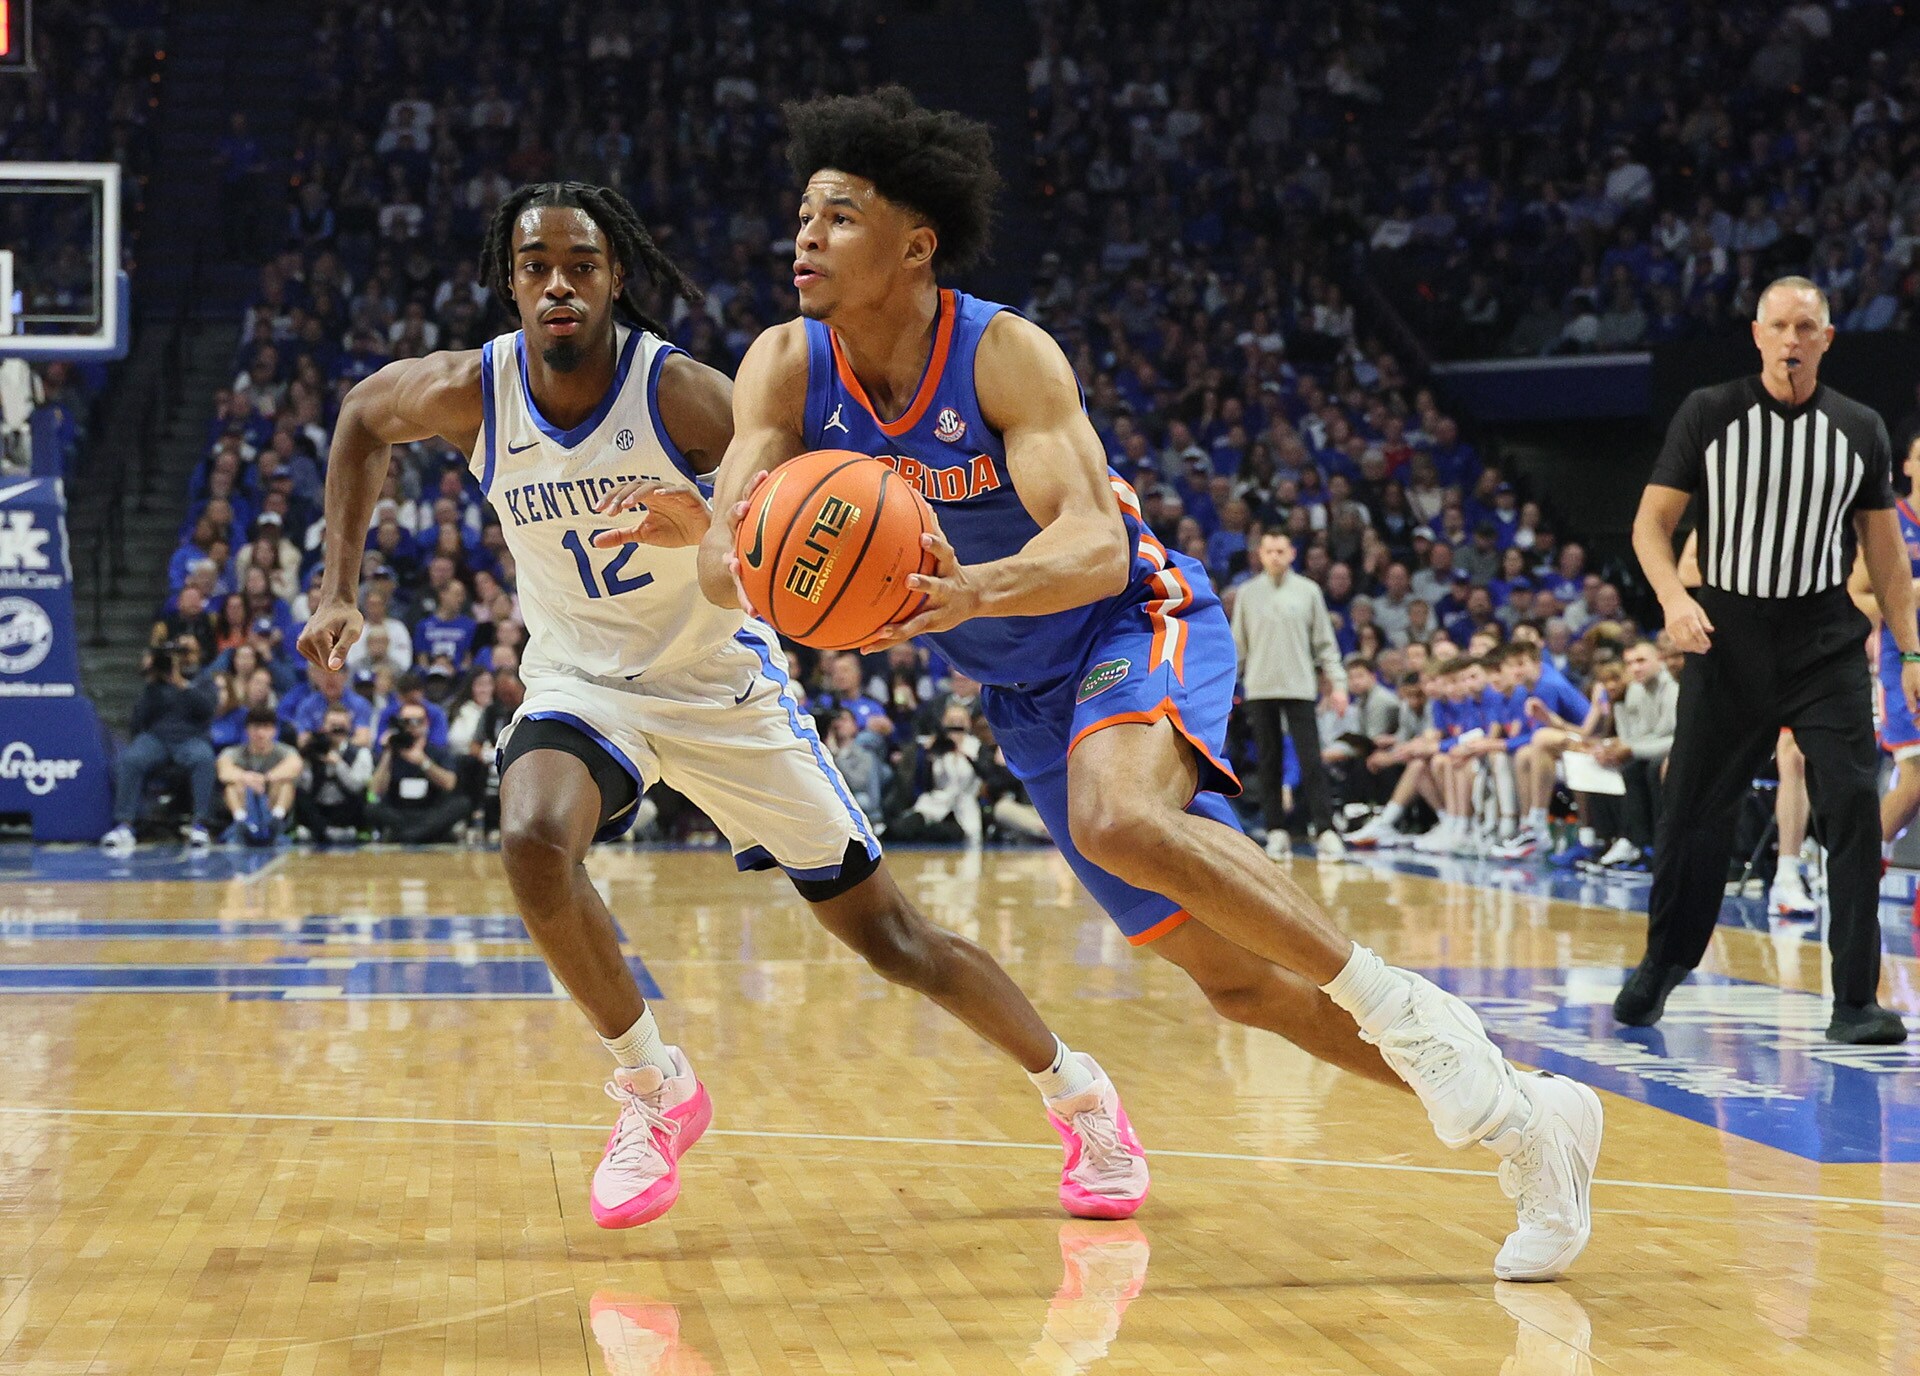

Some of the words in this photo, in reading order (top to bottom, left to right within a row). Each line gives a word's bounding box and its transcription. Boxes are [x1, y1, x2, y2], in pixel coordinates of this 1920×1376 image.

[616, 429, 634, 450] SEC
[939, 409, 959, 434] SEC
[504, 475, 661, 526] KENTUC
[873, 454, 1001, 502] RIDA
[561, 528, 655, 598] 12
[784, 495, 855, 601] ELITE
